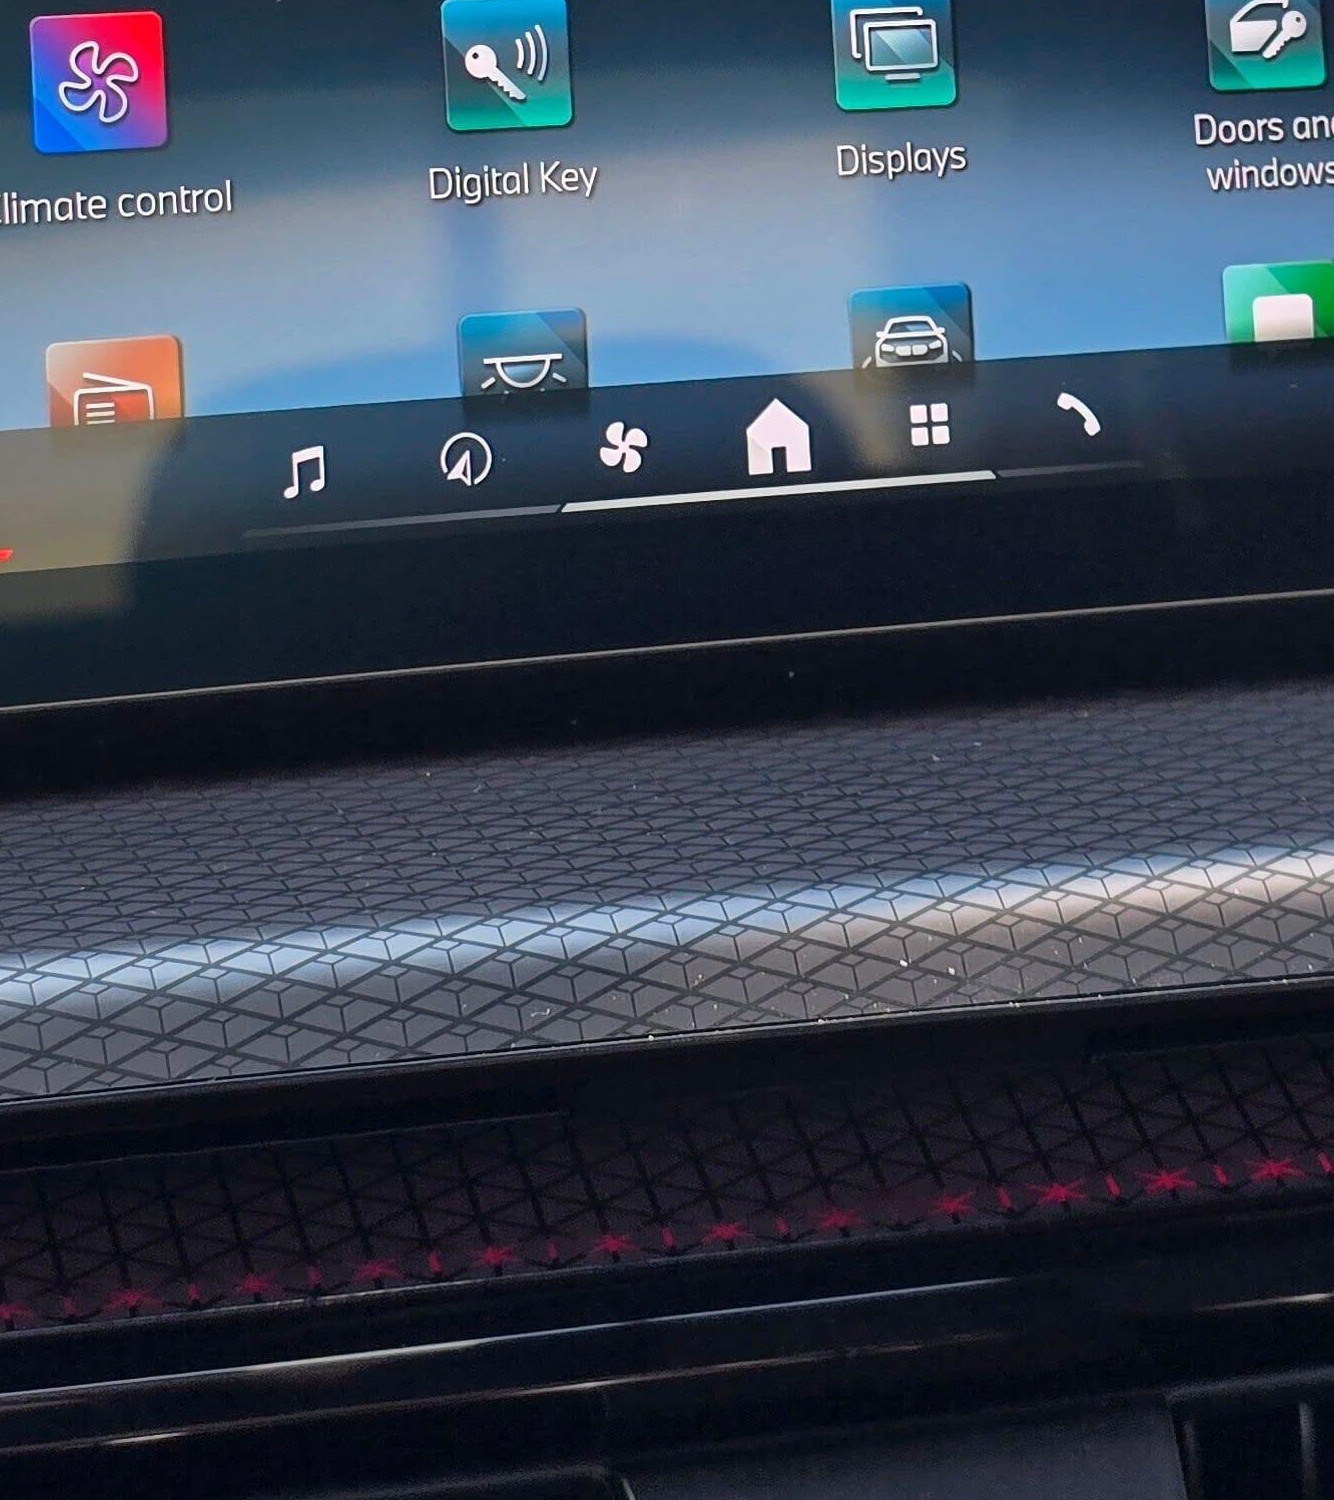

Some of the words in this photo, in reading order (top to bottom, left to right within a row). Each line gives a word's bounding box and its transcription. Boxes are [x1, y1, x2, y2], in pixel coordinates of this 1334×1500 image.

[1193, 113, 1284, 145] Doors
[836, 141, 966, 180] Displays
[118, 179, 232, 217] control
[429, 162, 529, 204] Digital
[540, 160, 598, 197] Key
